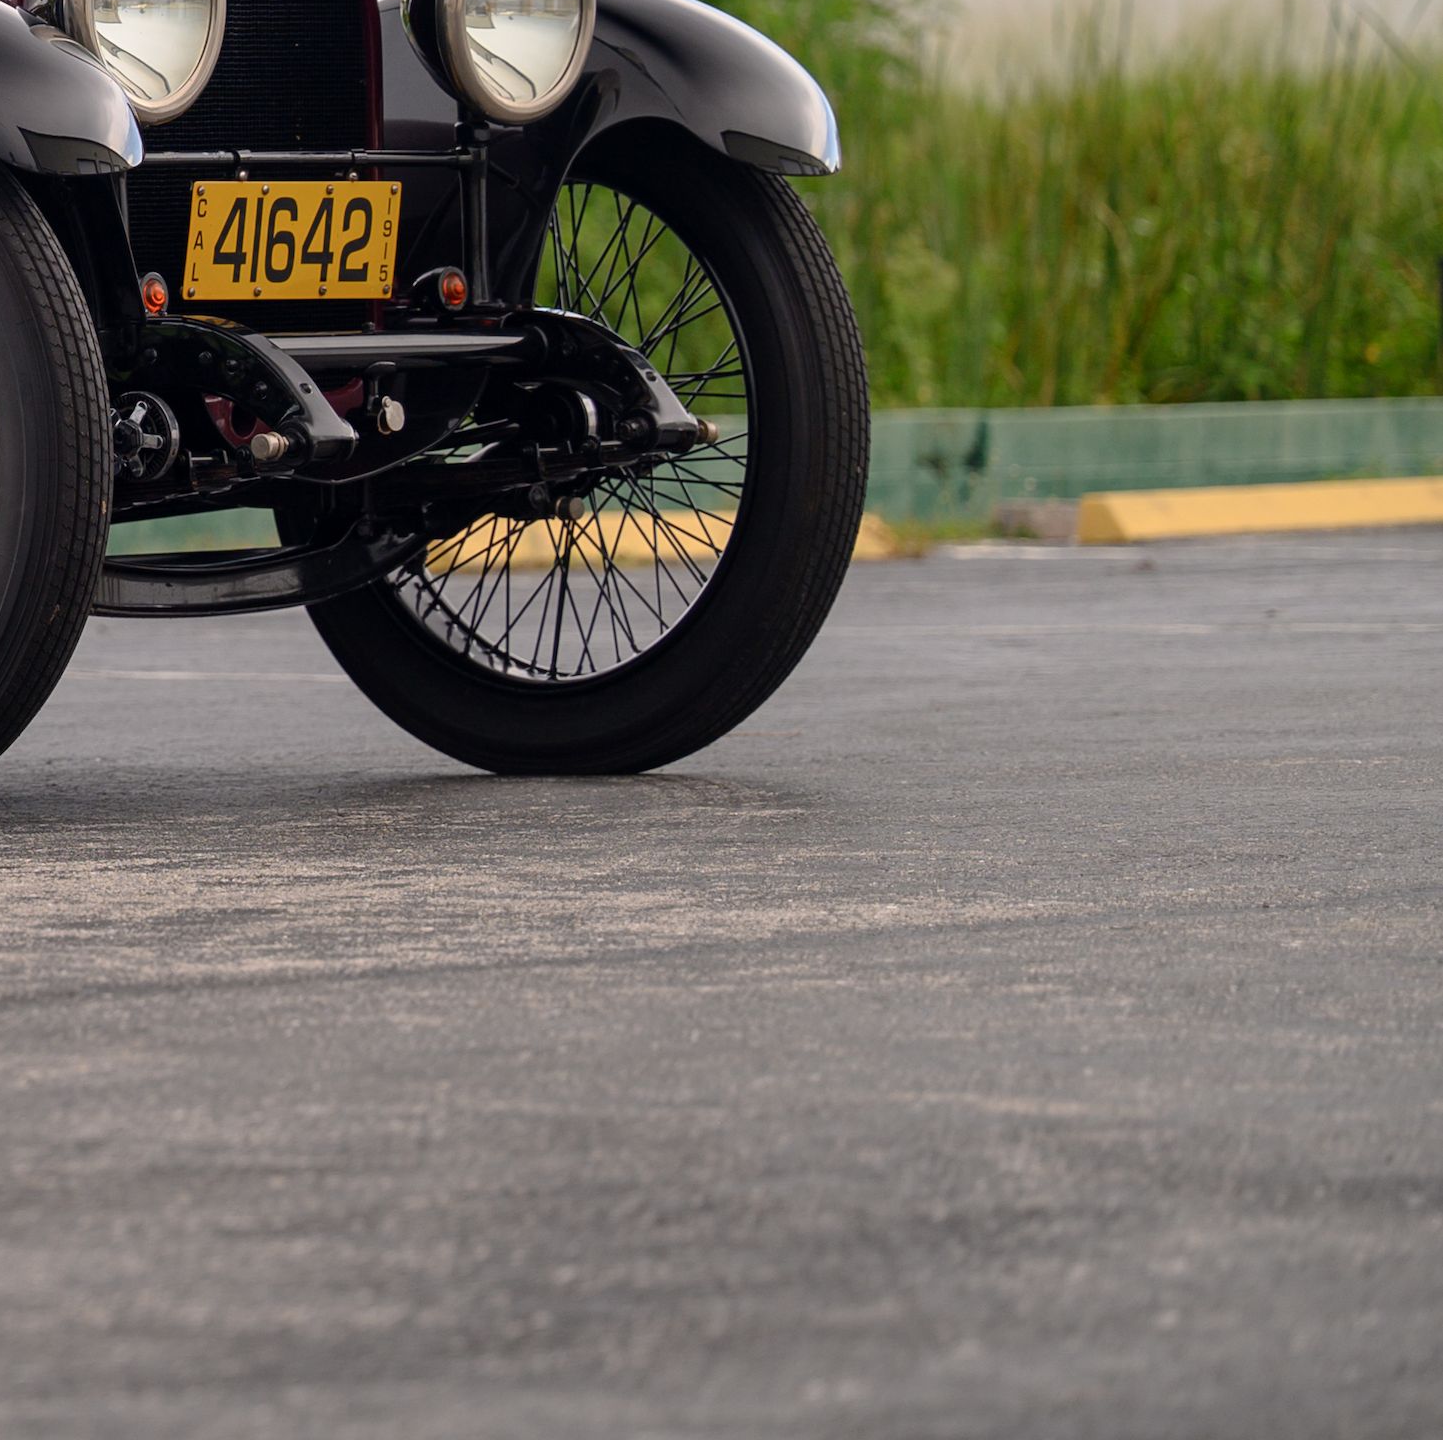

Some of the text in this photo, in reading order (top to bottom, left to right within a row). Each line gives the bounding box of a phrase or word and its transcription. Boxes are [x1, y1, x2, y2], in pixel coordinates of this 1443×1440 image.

[191, 198, 208, 282] CAL
[212, 196, 373, 284] 41642
[379, 197, 393, 282] 1915
